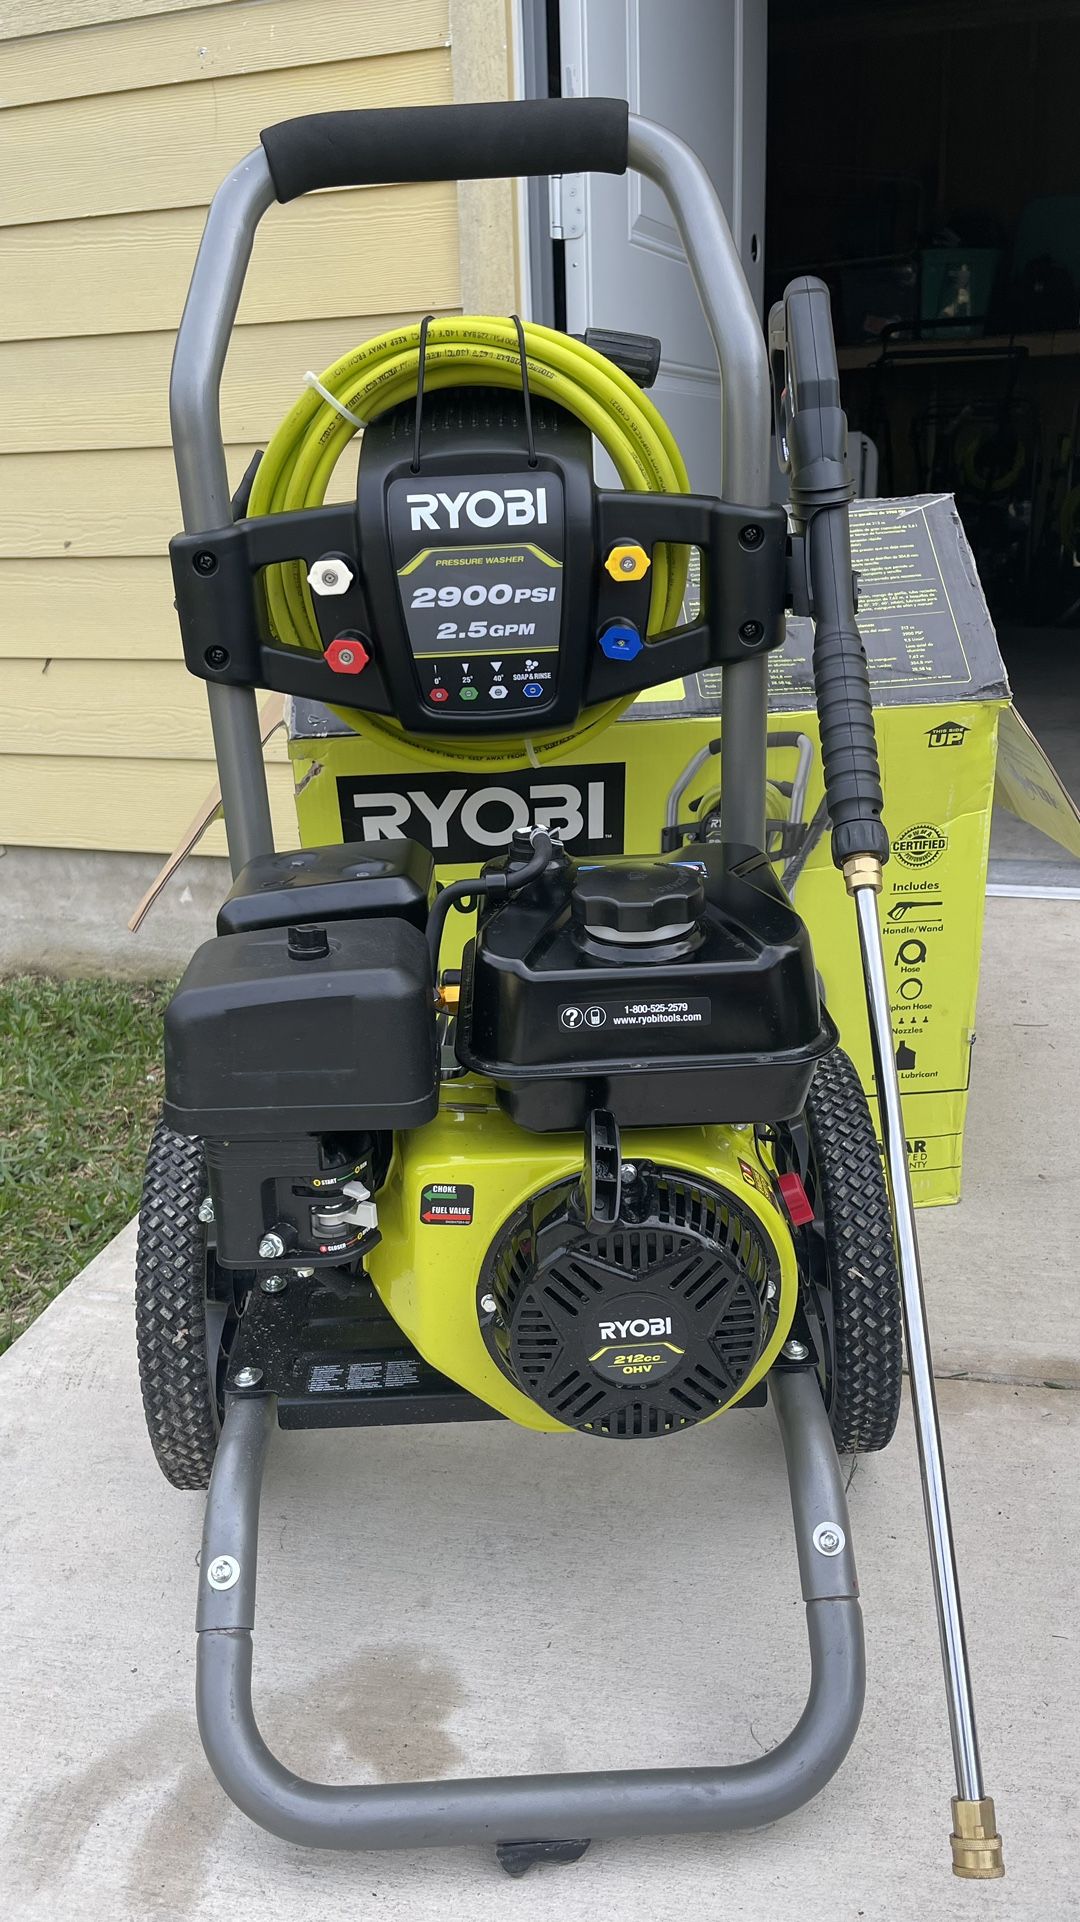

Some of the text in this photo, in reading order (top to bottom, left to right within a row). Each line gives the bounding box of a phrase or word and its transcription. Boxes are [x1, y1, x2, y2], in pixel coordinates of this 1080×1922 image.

[390, 335, 408, 347] KEEP
[368, 342, 387, 355] AWAY
[406, 488, 548, 531] RYOBI
[435, 555, 525, 566] PRESSURE WASHER
[462, 675, 473, 683] 25°
[493, 674, 504, 682] 40°
[930, 732, 963, 747] UP
[353, 781, 605, 848] RYOBI
[892, 839, 946, 851] CERTIFIED
[893, 881, 940, 892] Includes
[882, 925, 944, 935] Handle/Wand
[624, 1003, 688, 1014] 1-800-525-2579
[613, 1013, 702, 1026] www.ryobitools.com
[892, 1027, 923, 1035] Nozzles
[901, 1071, 938, 1079] Lubricant
[432, 1185, 457, 1193] CHOKE
[431, 1206, 470, 1215] FUEL VALVE
[598, 1317, 672, 1339] RYOBI
[613, 1354, 661, 1365] 212cc
[622, 1365, 652, 1374] OHV
